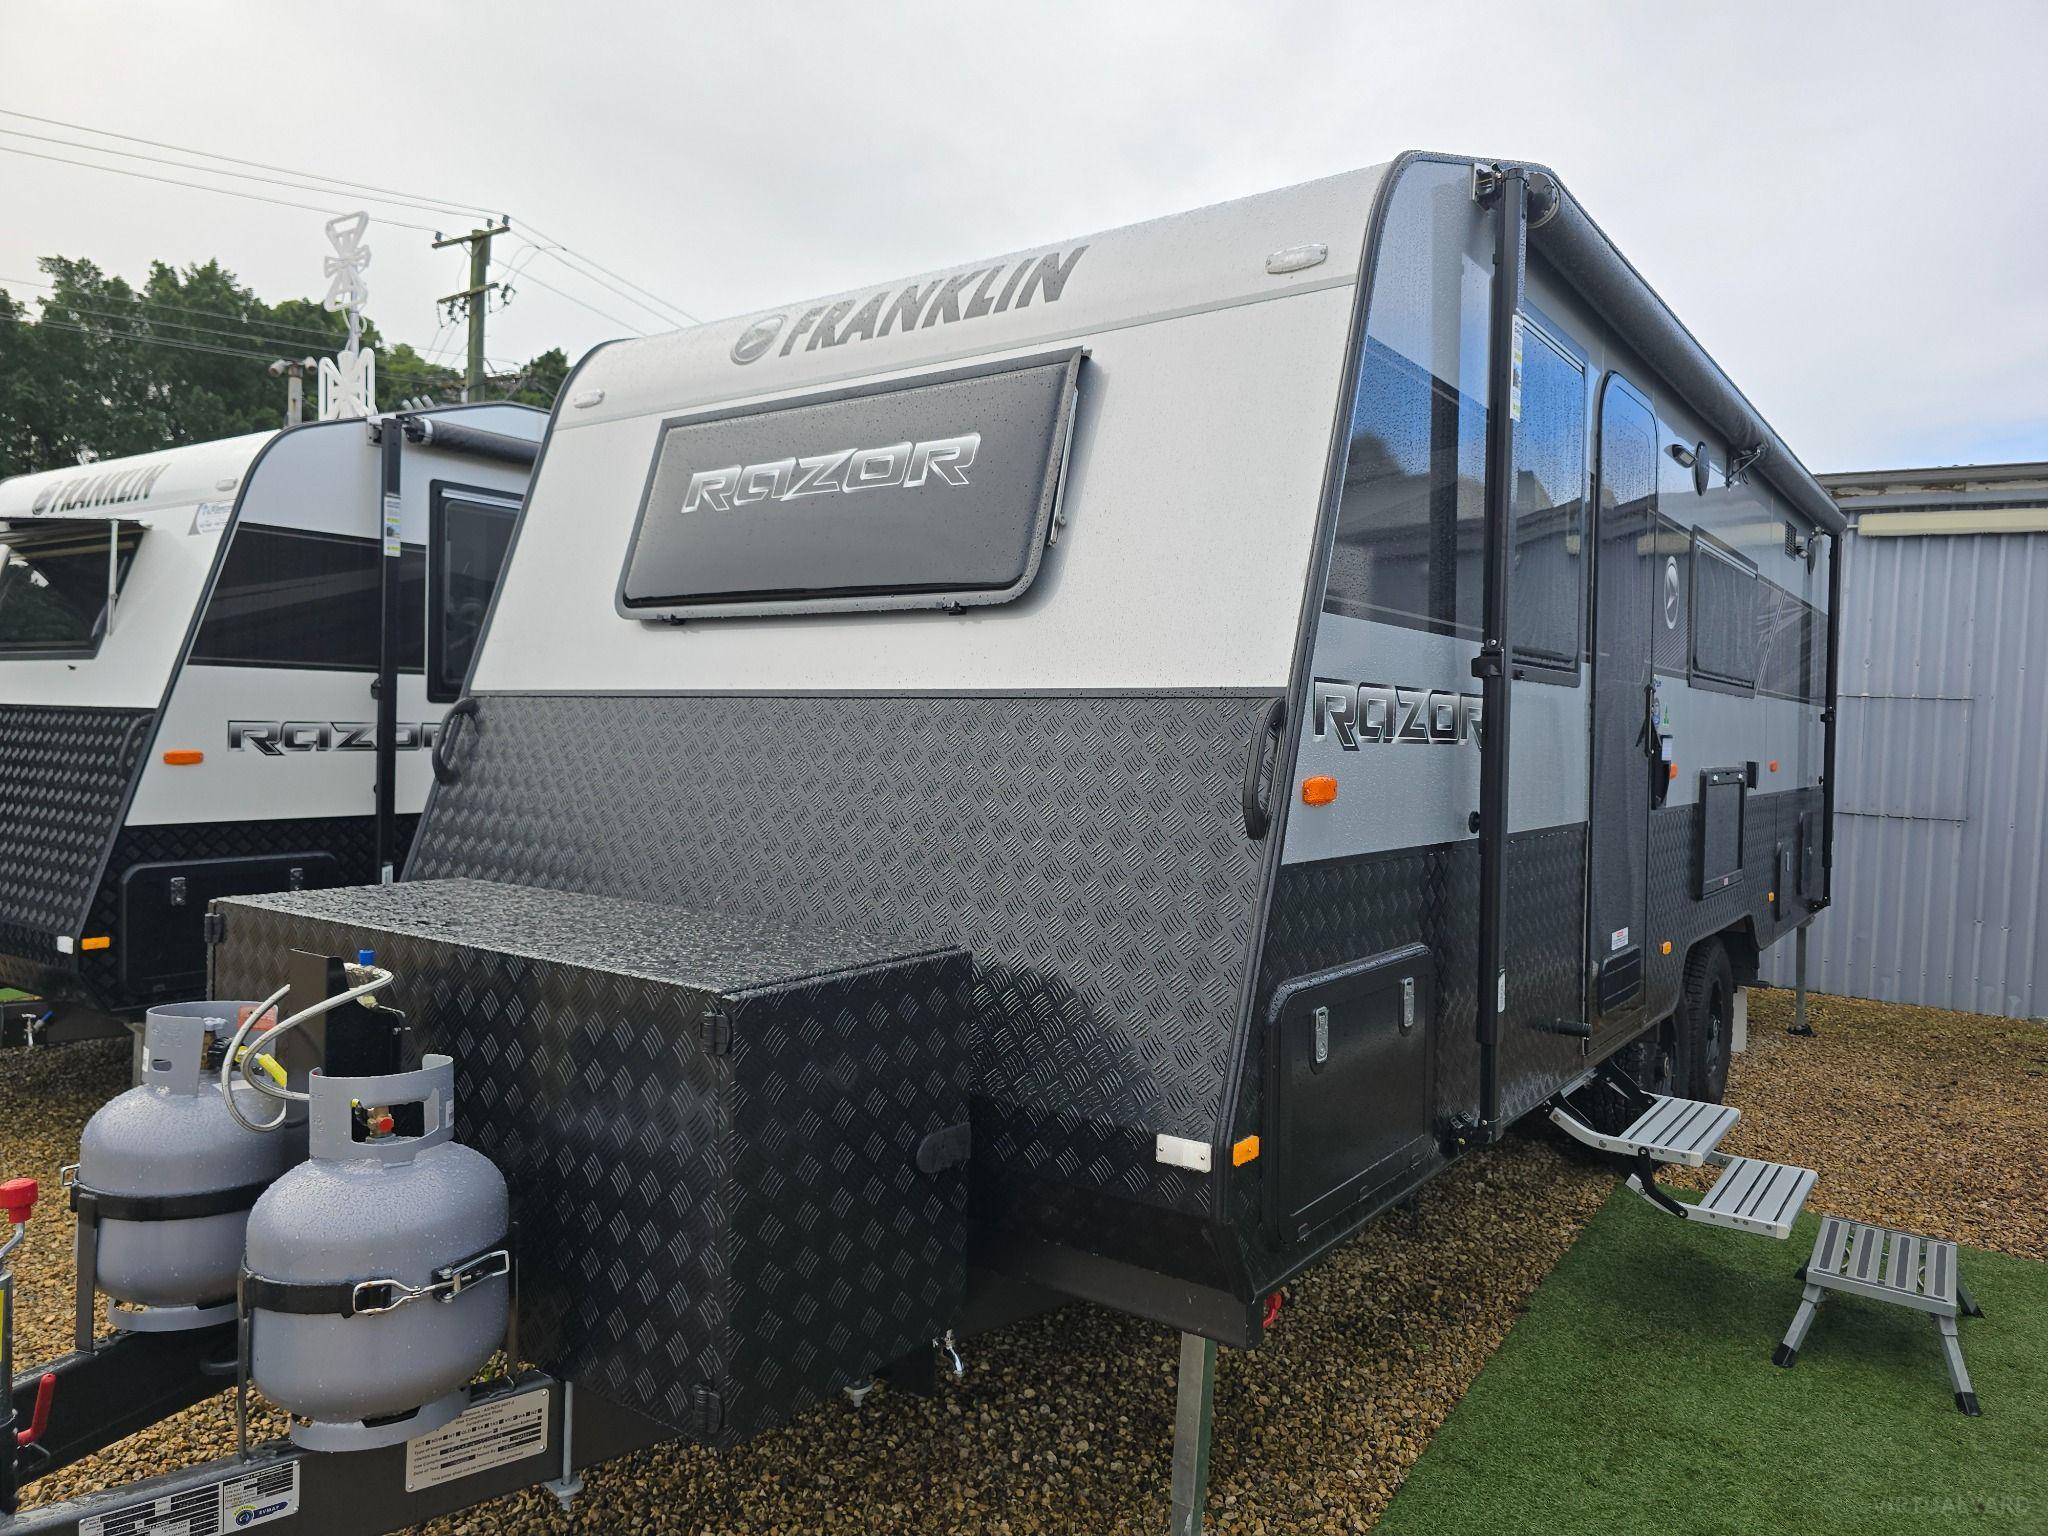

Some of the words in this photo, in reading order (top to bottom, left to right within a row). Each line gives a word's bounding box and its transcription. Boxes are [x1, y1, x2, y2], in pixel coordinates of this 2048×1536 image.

[778, 244, 1090, 357] FRANKLIN
[51, 463, 172, 513] FRANKLIN
[681, 432, 981, 514] RAZOR
